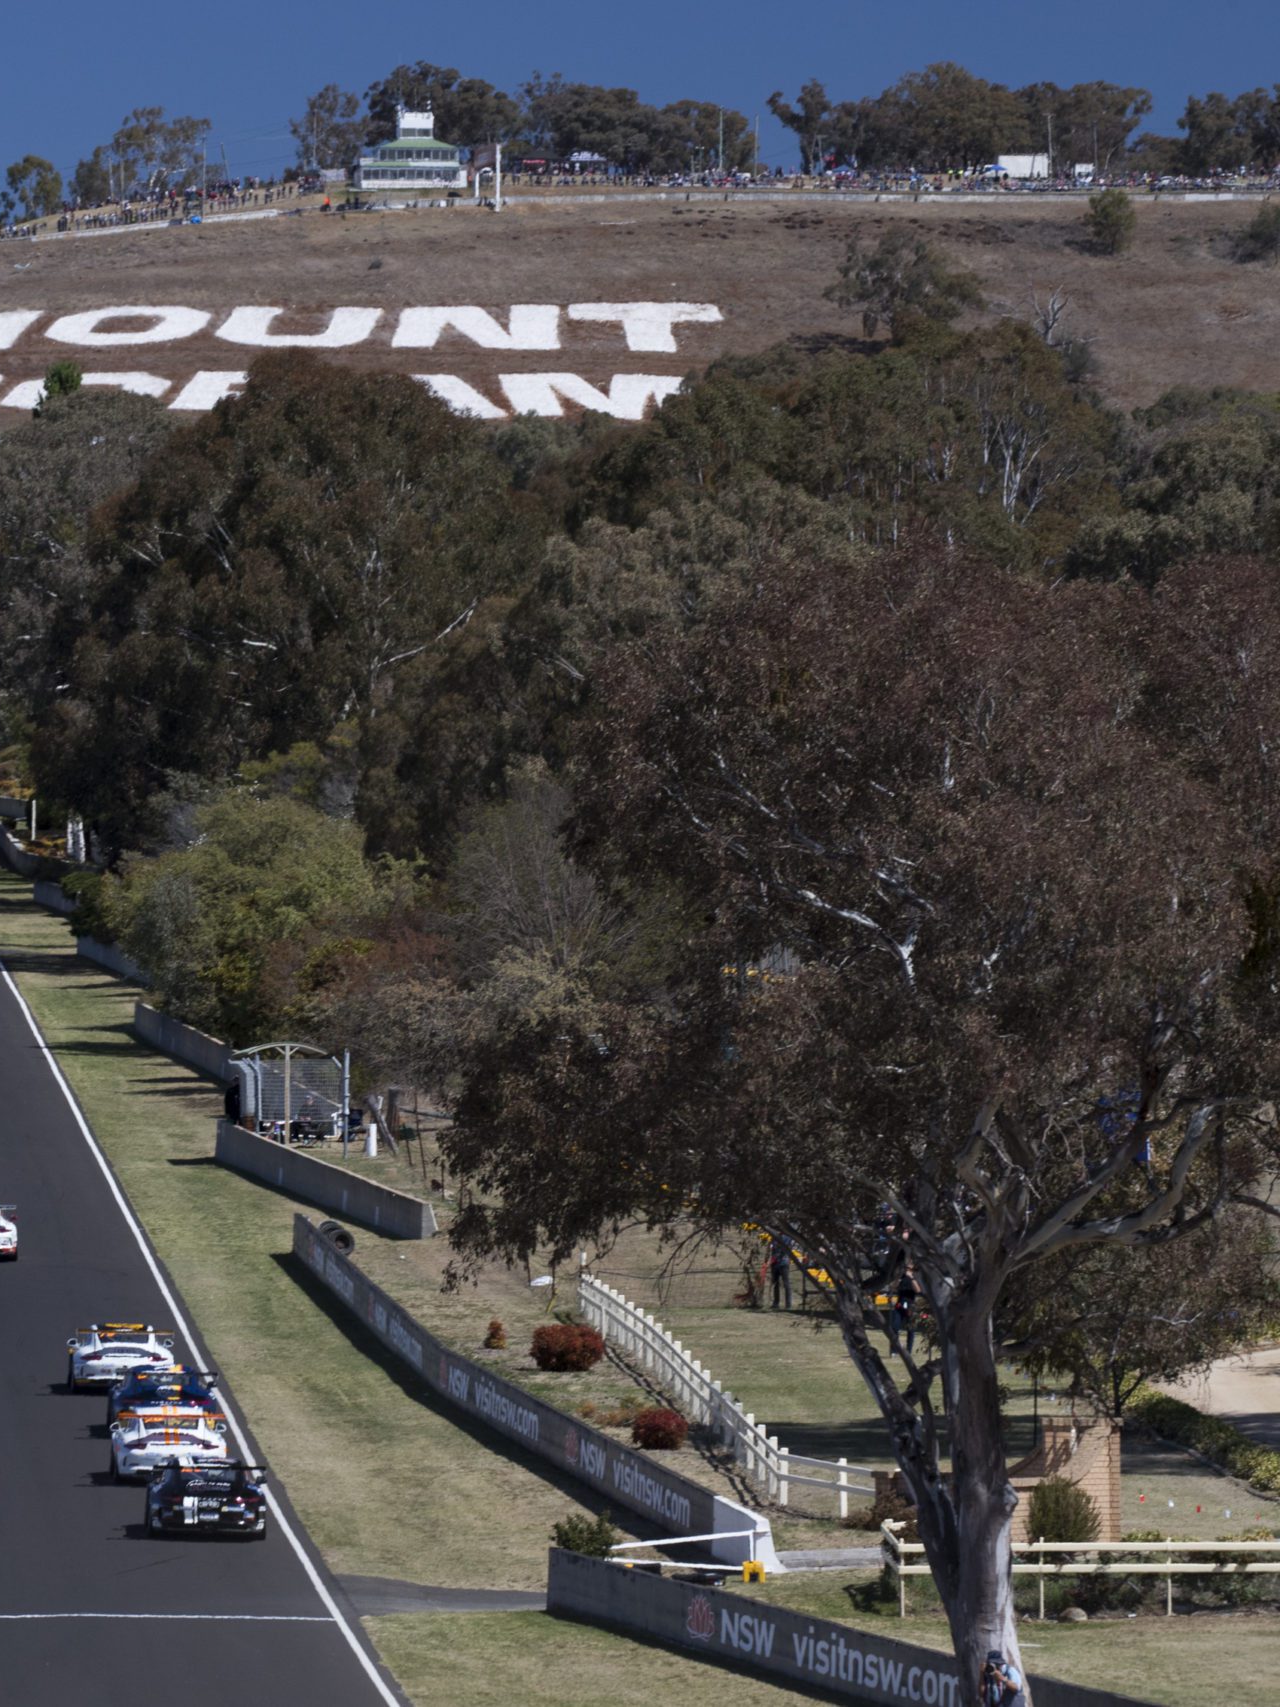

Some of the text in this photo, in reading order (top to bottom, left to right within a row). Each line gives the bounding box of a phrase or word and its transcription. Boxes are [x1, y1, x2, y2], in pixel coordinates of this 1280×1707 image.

[448, 1366, 539, 1441] NSW visitnsw.com
[579, 1438, 691, 1529] NSW visitnsw.com
[720, 1609, 961, 1707] NSW visitnsw.com
